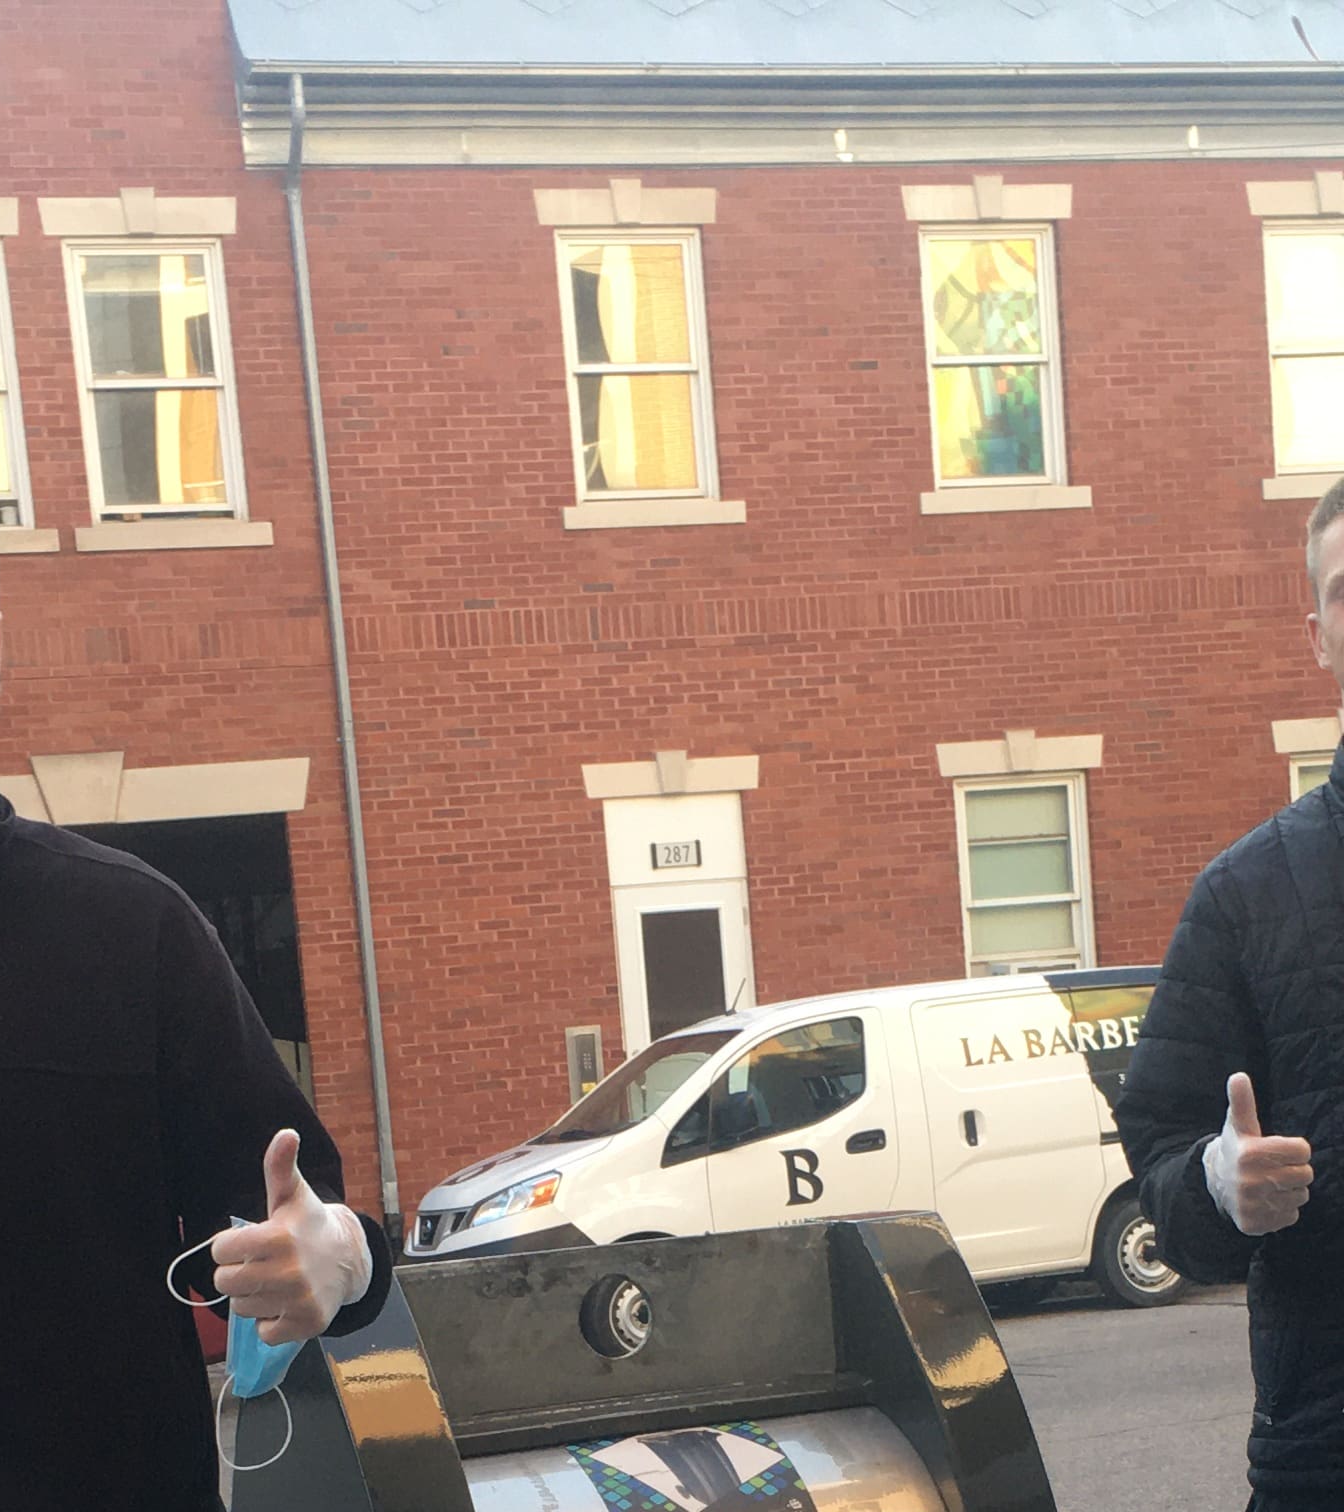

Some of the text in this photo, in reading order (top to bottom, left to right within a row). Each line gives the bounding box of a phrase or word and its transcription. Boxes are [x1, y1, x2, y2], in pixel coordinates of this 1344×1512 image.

[663, 845, 690, 864] 287
[960, 1014, 1145, 1067] LA BARBE
[778, 1148, 824, 1207] B
